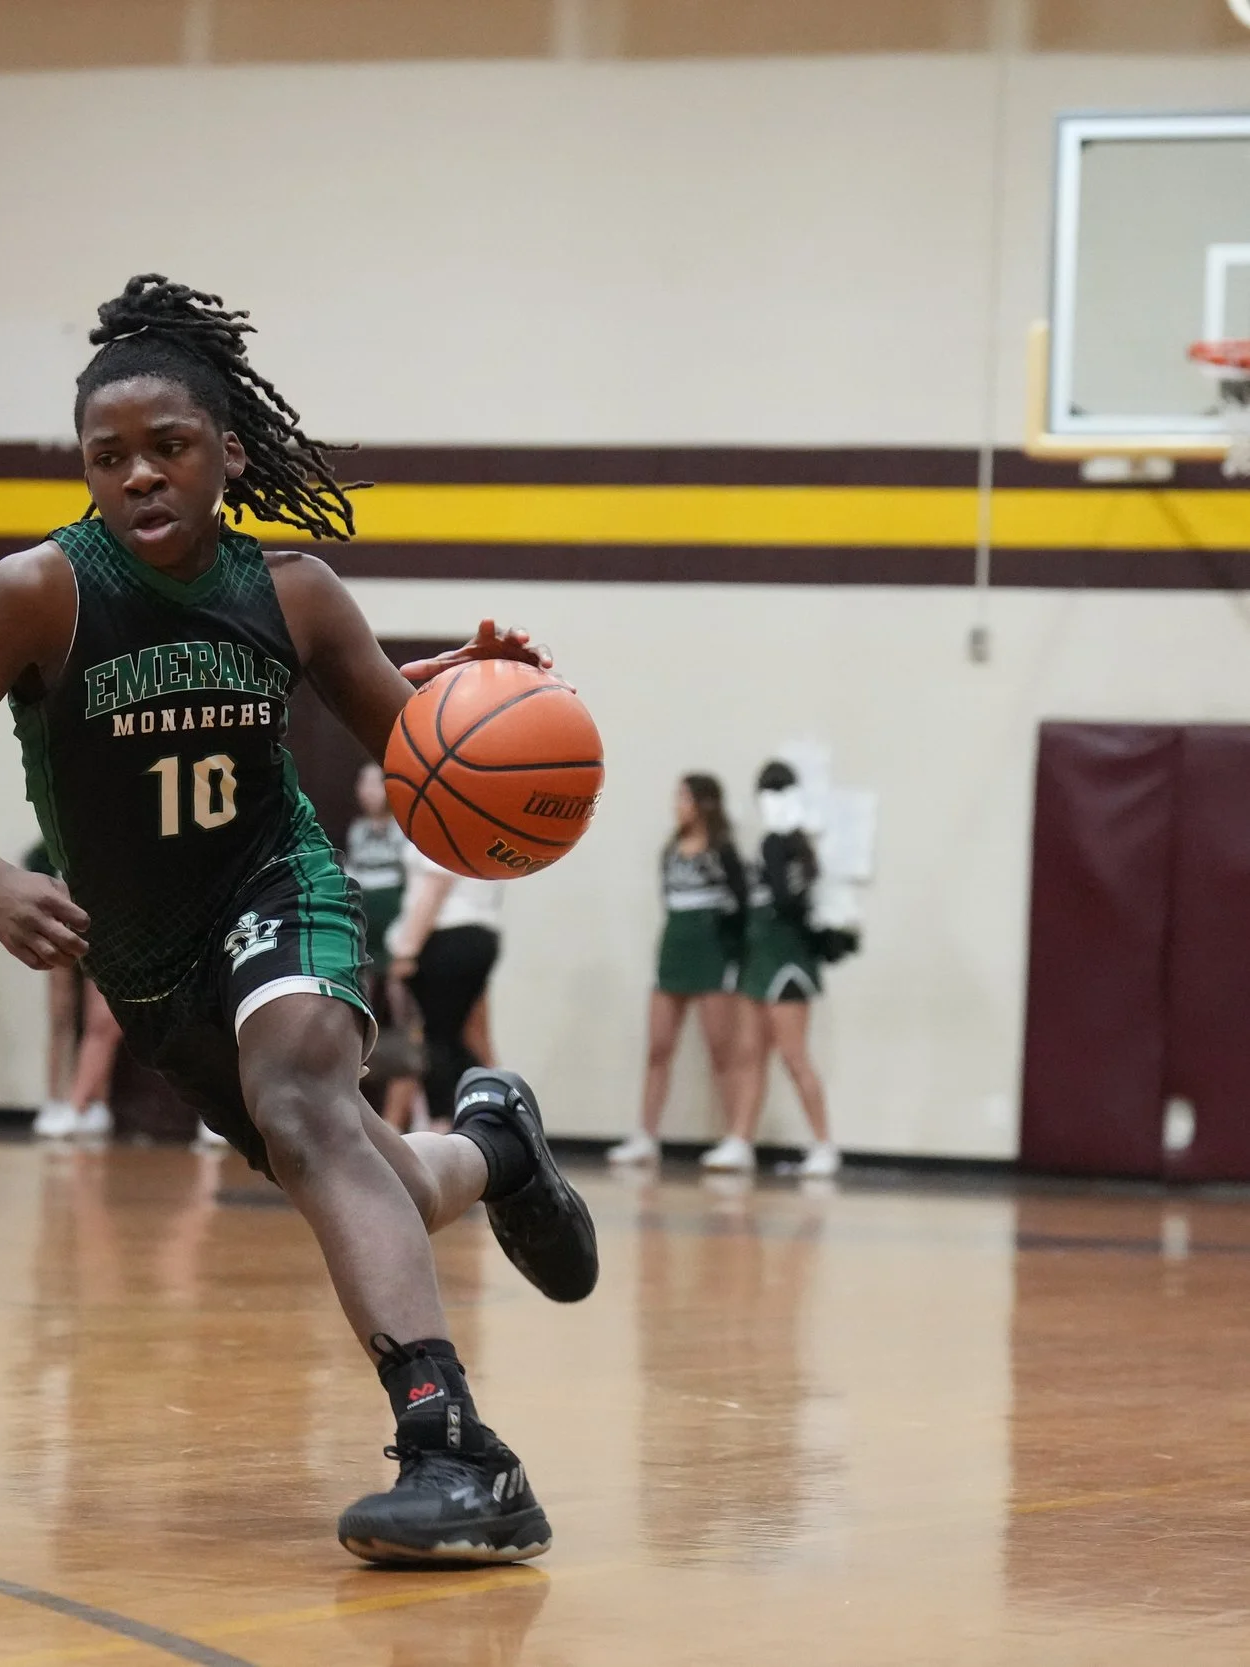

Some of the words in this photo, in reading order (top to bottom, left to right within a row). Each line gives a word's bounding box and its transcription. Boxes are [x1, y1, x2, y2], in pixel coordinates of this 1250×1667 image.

[85, 640, 291, 720] EMERALD
[112, 701, 271, 737] MONARCHS
[147, 754, 238, 838] 10
